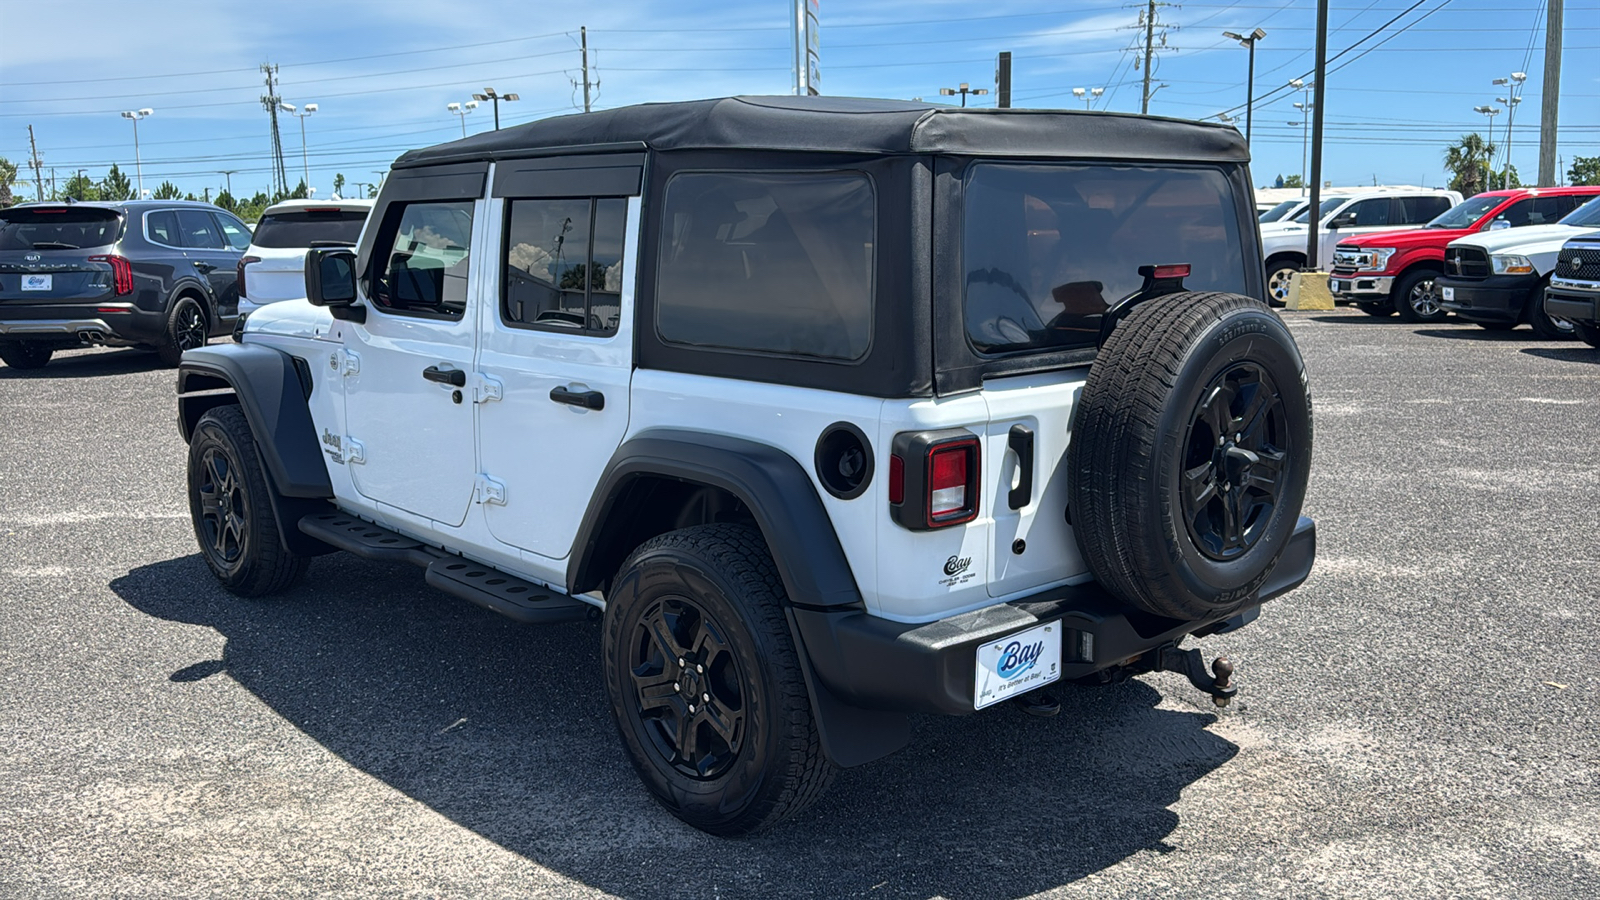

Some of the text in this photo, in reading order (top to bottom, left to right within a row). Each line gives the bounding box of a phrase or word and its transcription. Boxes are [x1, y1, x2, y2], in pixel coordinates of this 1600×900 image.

[322, 427, 342, 452] Jeep
[945, 555, 972, 573] Bay
[1000, 640, 1044, 672] Bay
[1007, 678, 1024, 689] Better
[1024, 675, 1030, 683] at
